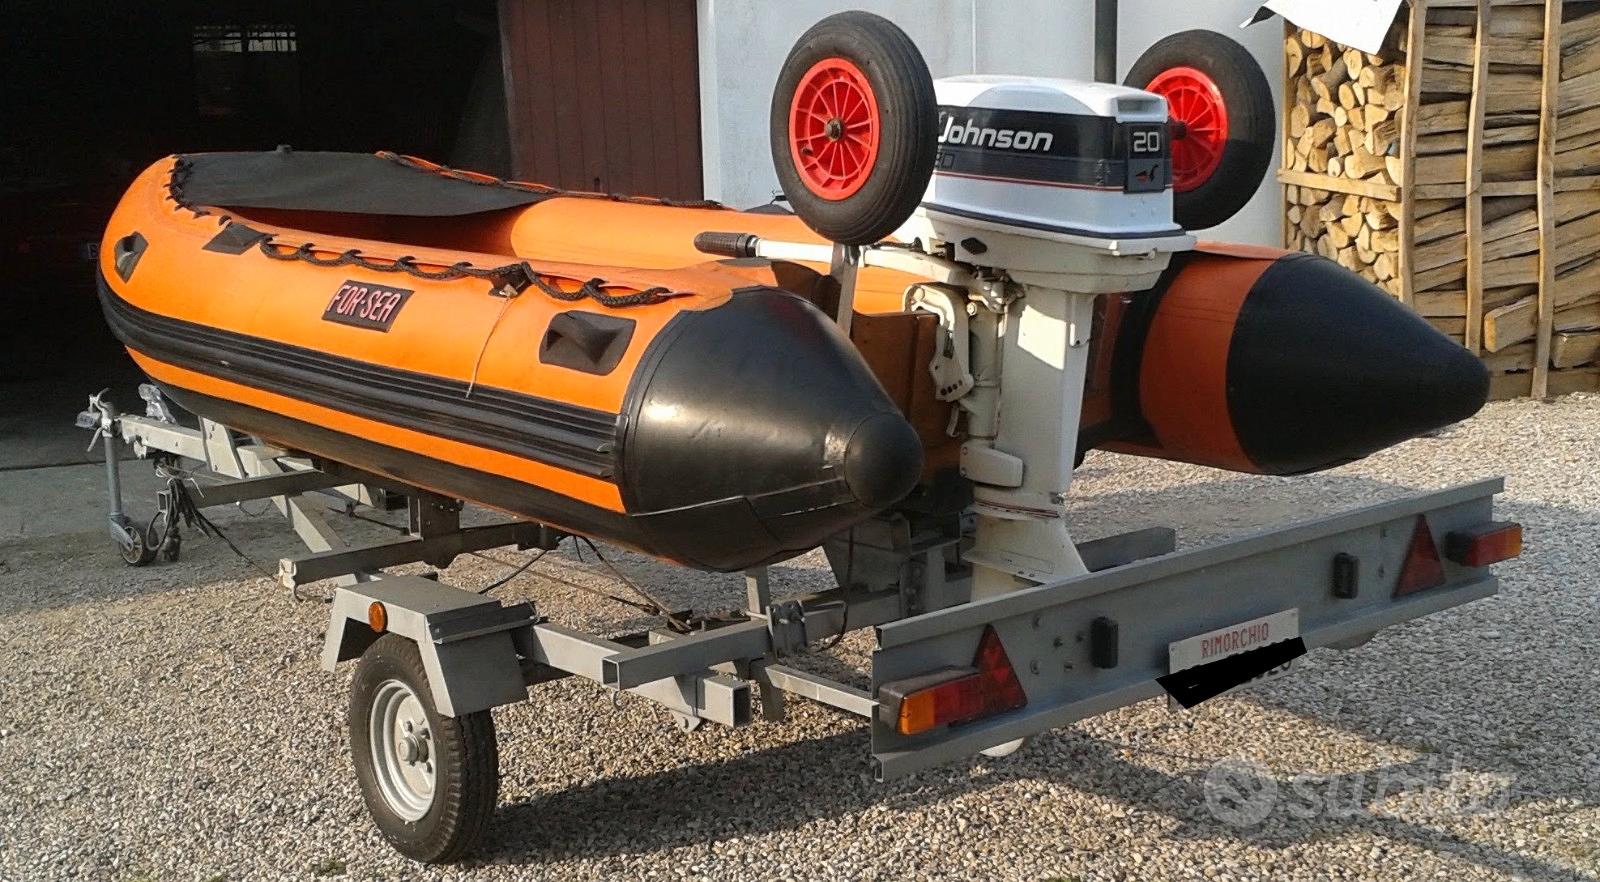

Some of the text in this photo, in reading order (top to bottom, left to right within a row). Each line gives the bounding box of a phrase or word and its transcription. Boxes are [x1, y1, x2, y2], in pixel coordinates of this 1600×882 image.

[938, 115, 1054, 152] Johnson
[1132, 131, 1161, 153] 20
[1201, 622, 1270, 658] RIMORCHIO
